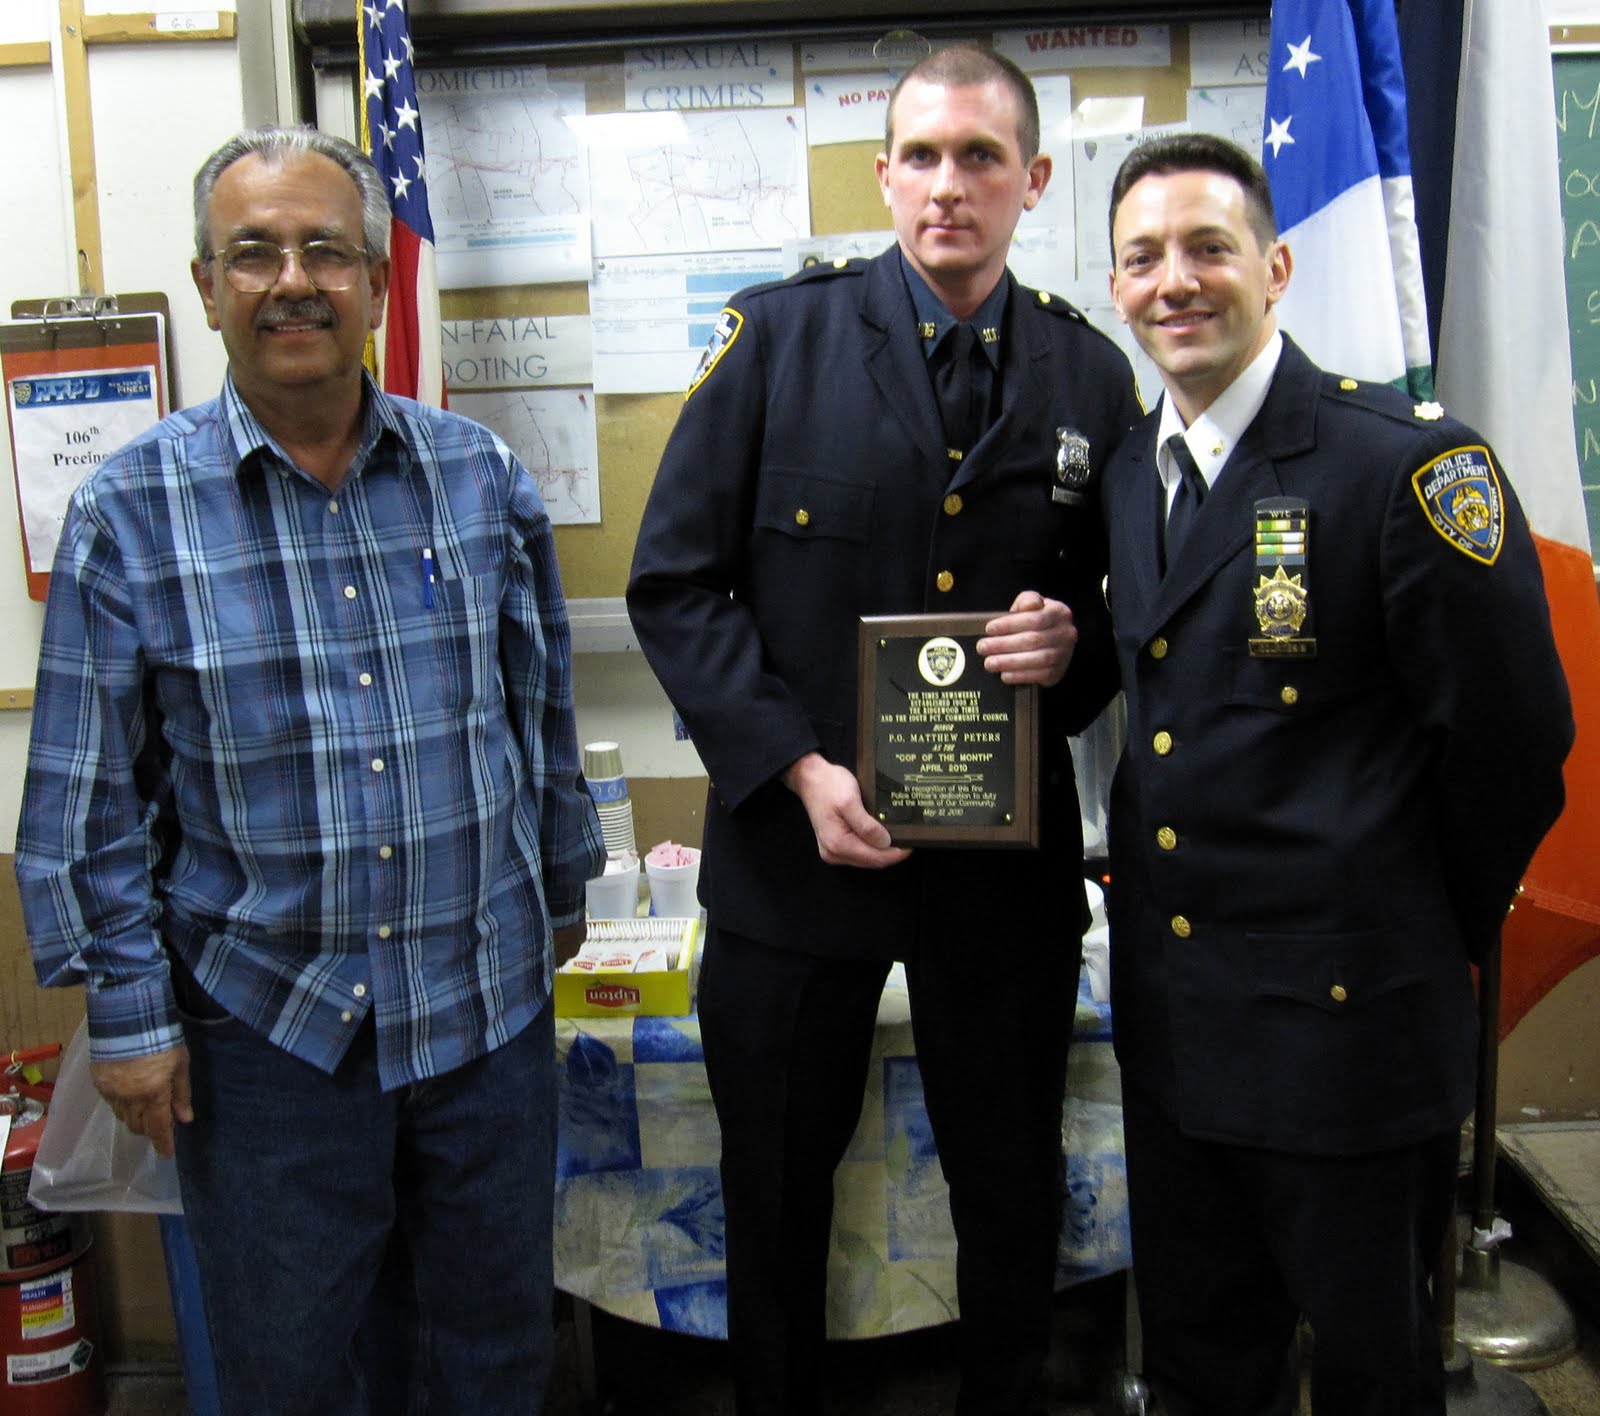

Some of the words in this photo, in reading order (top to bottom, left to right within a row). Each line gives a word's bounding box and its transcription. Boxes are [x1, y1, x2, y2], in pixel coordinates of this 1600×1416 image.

[1025, 26, 1139, 53] WANTED
[640, 42, 771, 72] SEXUAL
[418, 67, 537, 93] OMICIDE
[642, 82, 764, 111] CRIMES
[838, 92, 862, 107] NO
[441, 316, 557, 345] N-FATAL
[442, 354, 548, 383] OTING
[117, 384, 149, 394] FINEST
[64, 425, 100, 445] 106th
[1433, 453, 1474, 476] POLICE
[1424, 465, 1489, 500] DEPARTMENT
[1433, 513, 1457, 537] CITY
[1458, 536, 1474, 550] OF
[1489, 522, 1500, 549] NEW
[908, 691, 919, 700] THE
[921, 691, 940, 700] TIMES
[910, 699, 951, 707] ESTABLISHED
[881, 714, 894, 722] AND
[895, 714, 907, 722] THE
[945, 713, 980, 722] COMMUNITY
[982, 712, 1009, 721] COUNCIL
[909, 707, 920, 715] THE
[923, 706, 960, 714] RIDGEWOOD
[961, 706, 980, 714] TIMES
[888, 733, 906, 743] P.O.
[910, 733, 958, 742] MATTHEW
[964, 732, 1001, 742] PETERS
[895, 753, 917, 762] "COP
[921, 753, 933, 762] OF
[938, 753, 955, 762] THE
[960, 753, 993, 762] MONTH"
[920, 764, 943, 773] APRIL
[948, 763, 968, 772] 2010
[911, 785, 946, 793] recognition
[957, 784, 969, 792] this
[982, 792, 997, 800] duty
[589, 988, 637, 1002] Lipton
[21, 1288, 47, 1300] HEALTH
